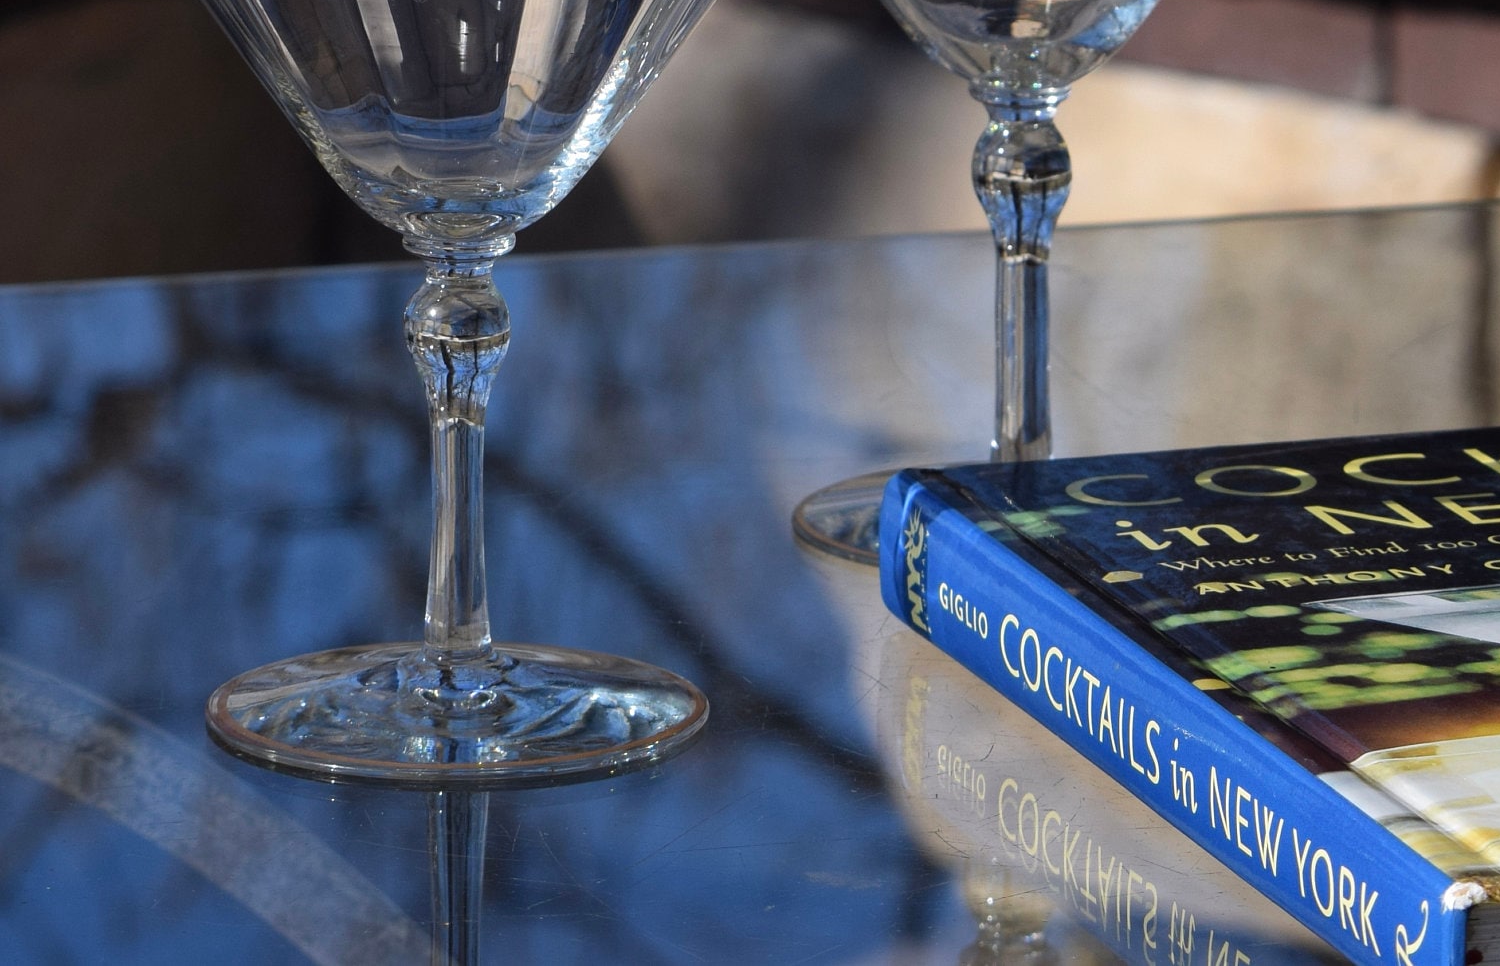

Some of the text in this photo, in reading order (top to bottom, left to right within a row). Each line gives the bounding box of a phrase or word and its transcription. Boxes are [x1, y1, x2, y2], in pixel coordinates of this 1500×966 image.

[1115, 519, 1261, 551] in
[1159, 554, 1276, 571] Where
[1283, 551, 1318, 563] to
[1327, 540, 1409, 561] Find
[1193, 562, 1454, 596] ANTHONY
[938, 581, 989, 640] GIGLIO
[999, 613, 1161, 785] COCKTAILS
[1169, 737, 1198, 814] in
[1209, 765, 1285, 878] NEW
[1292, 828, 1382, 958] YORK
